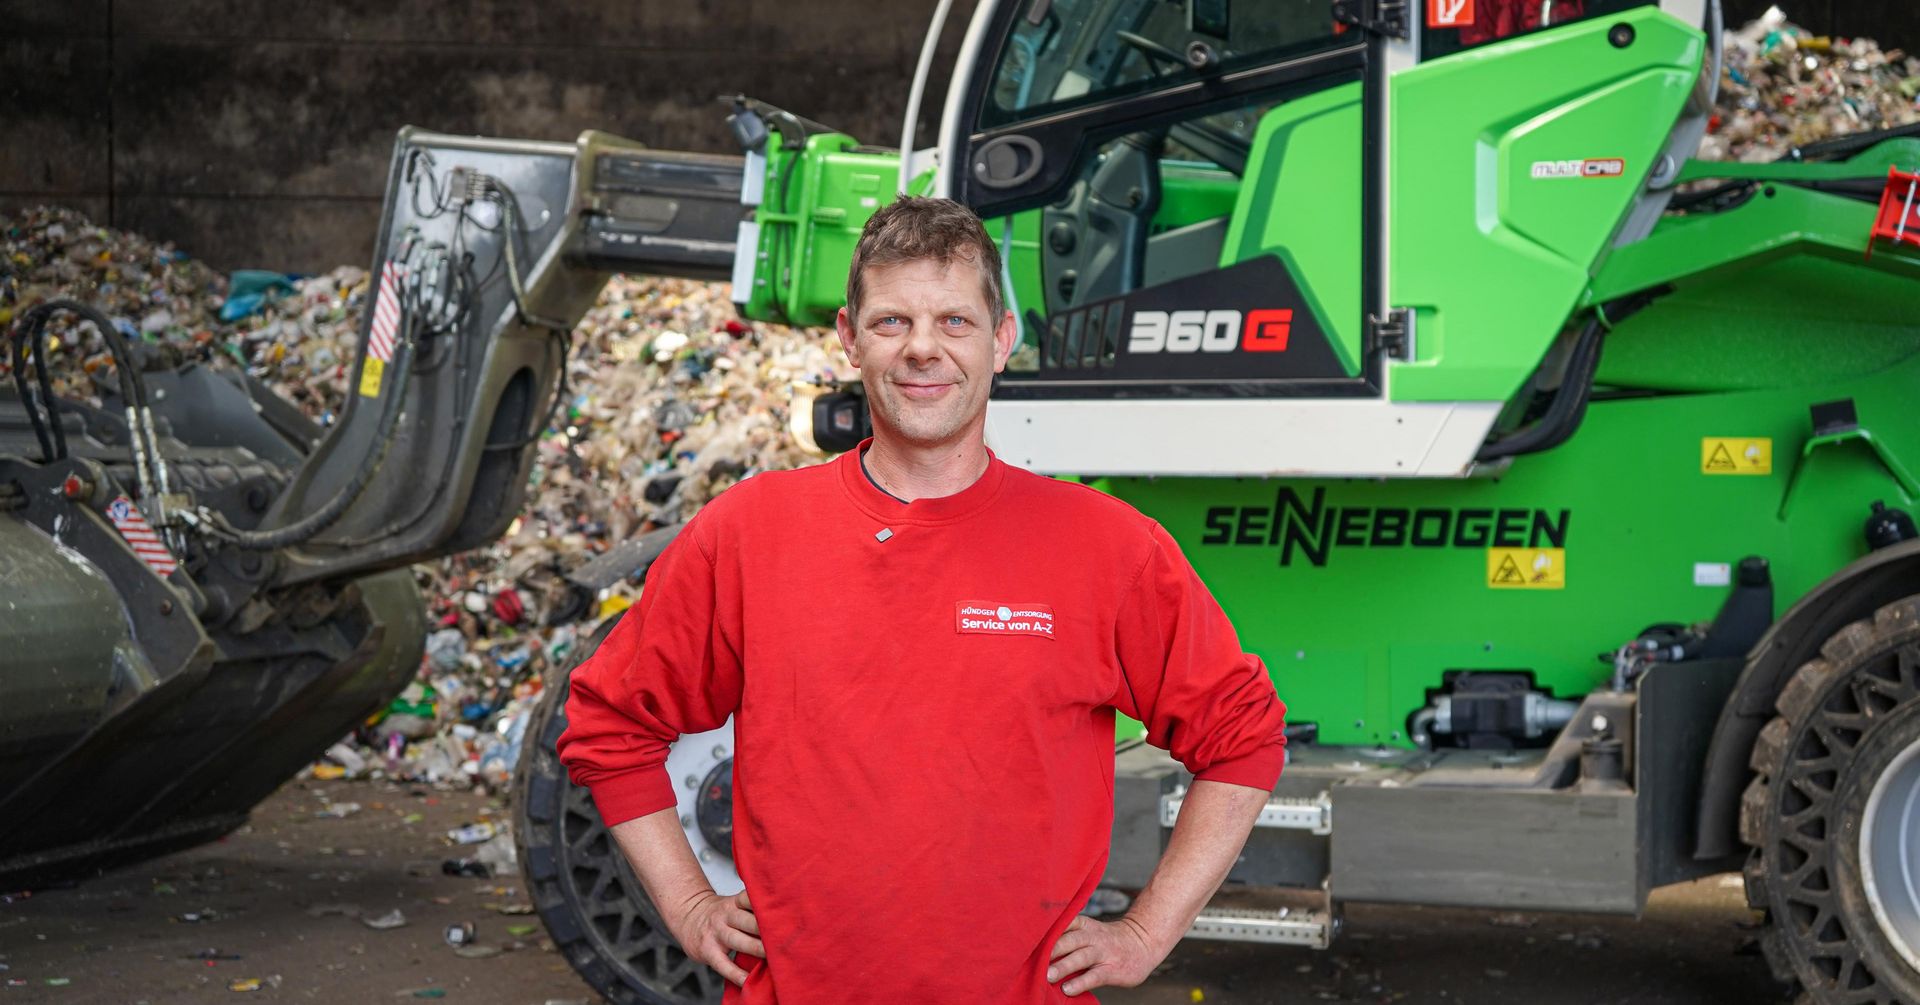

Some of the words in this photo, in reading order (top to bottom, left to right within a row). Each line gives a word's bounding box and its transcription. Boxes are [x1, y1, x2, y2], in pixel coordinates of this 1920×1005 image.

[1202, 486, 1571, 567] SENNEBOGEN
[961, 607, 995, 616] HÜNDGEN
[1013, 611, 1052, 620] ENTSORGUNG
[962, 619, 1005, 630] Service
[1008, 622, 1030, 630] von
